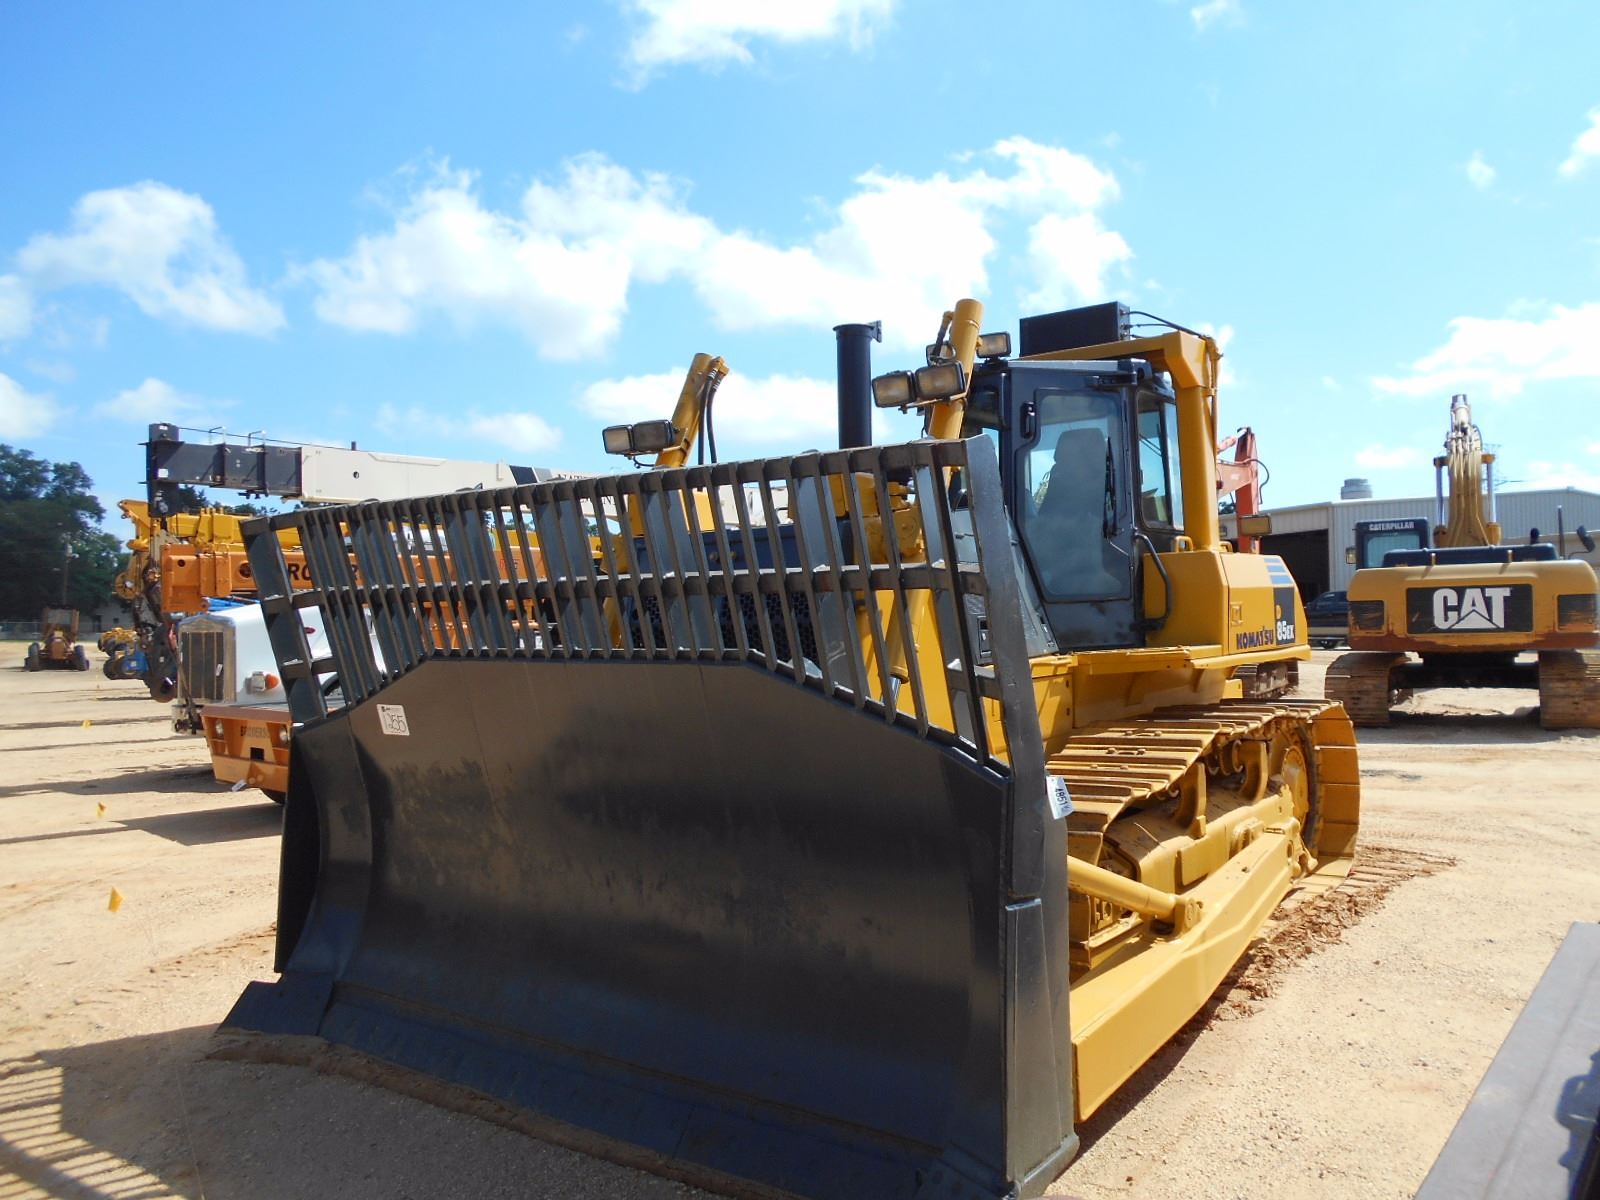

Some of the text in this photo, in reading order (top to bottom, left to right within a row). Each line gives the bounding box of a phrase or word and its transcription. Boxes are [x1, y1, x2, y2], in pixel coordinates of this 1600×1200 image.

[1369, 521, 1415, 531] CATERPILLAR
[1433, 587, 1511, 630] CAT
[1236, 625, 1274, 650] KOMATSU
